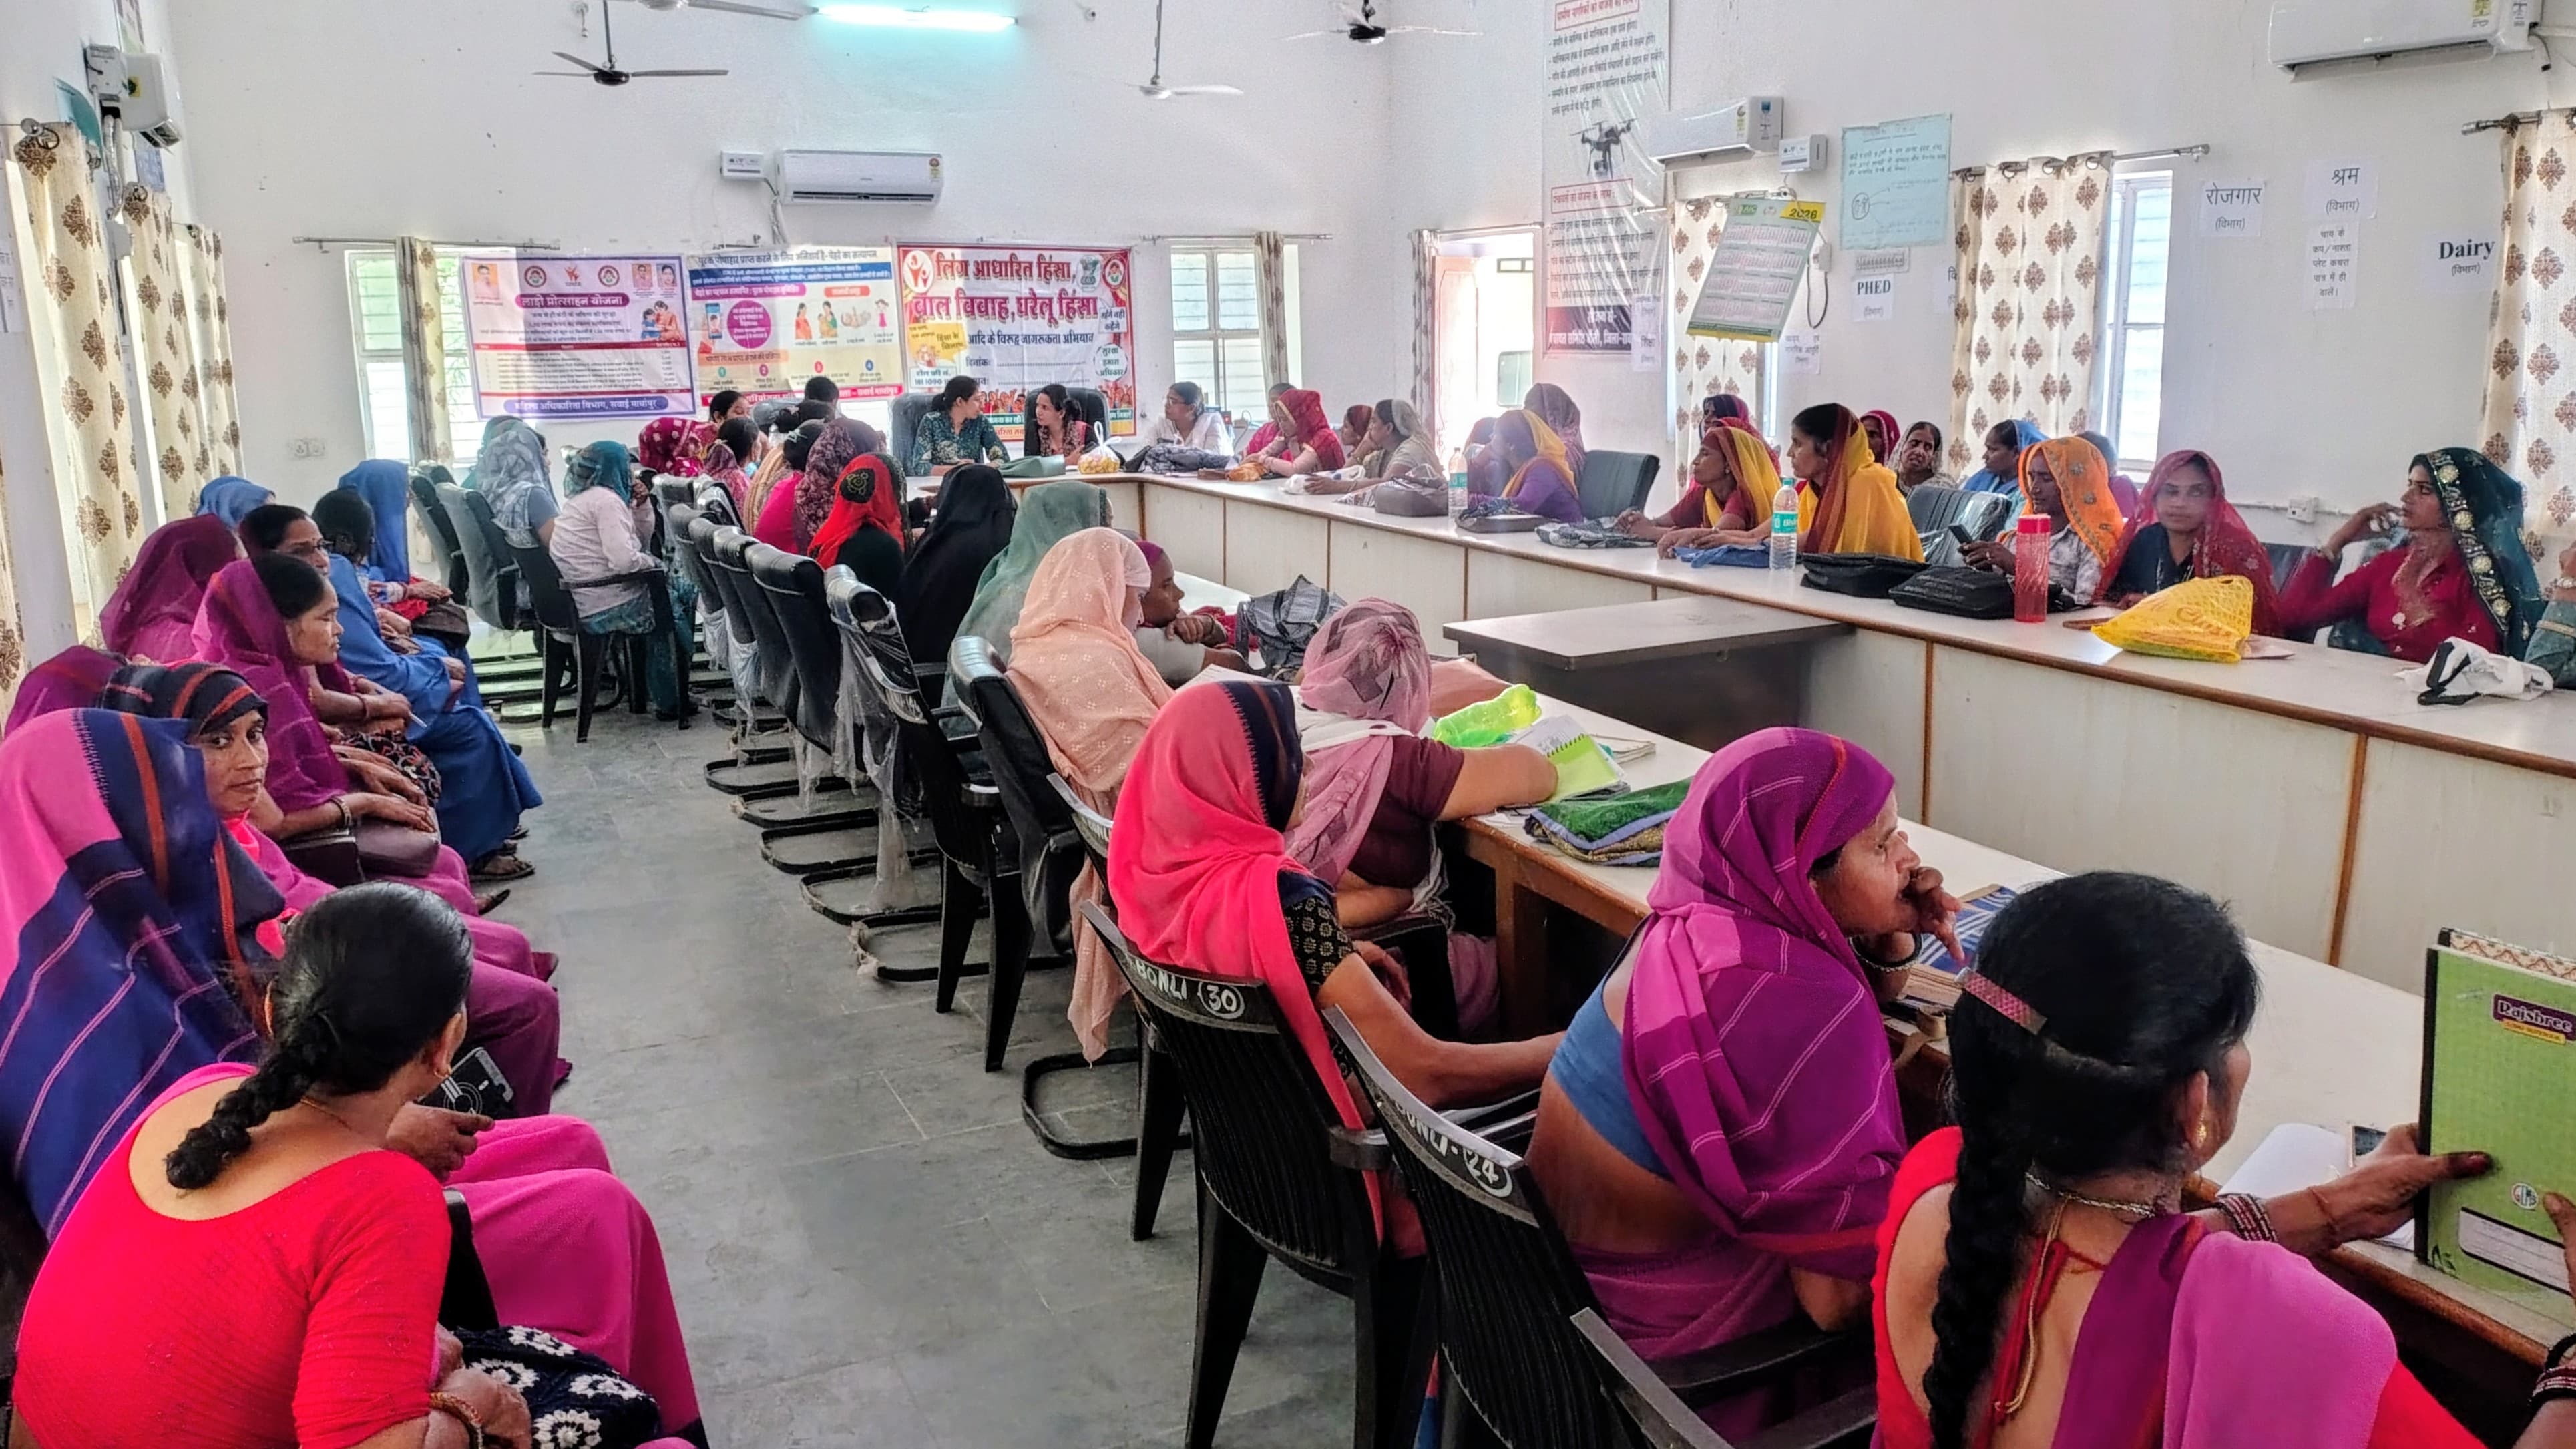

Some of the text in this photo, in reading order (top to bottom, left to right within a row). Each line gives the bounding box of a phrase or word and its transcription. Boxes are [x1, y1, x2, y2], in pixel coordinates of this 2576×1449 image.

[2332, 167, 2360, 186] श्रम
[2205, 182, 2262, 206] रोजगार
[1789, 208, 1817, 220] 2026
[2326, 198, 2359, 214] (विभाग)
[2215, 216, 2245, 231] (विभाग)
[2439, 238, 2495, 260] Dairy
[935, 253, 1076, 283] लिंग आधारित हिंसा,
[2451, 262, 2480, 276] (विभाग)
[2338, 272, 2346, 282] ही
[1857, 280, 1891, 295] PHED
[546, 294, 589, 307] प्रोत्साहन
[591, 294, 623, 306] योजना
[912, 296, 951, 319] बाल
[1057, 288, 1099, 320] हिंसा
[968, 330, 986, 344] आदि
[988, 329, 995, 344] के
[1136, 959, 1237, 1012] BONLI 30
[1467, 1148, 1499, 1184] 24
